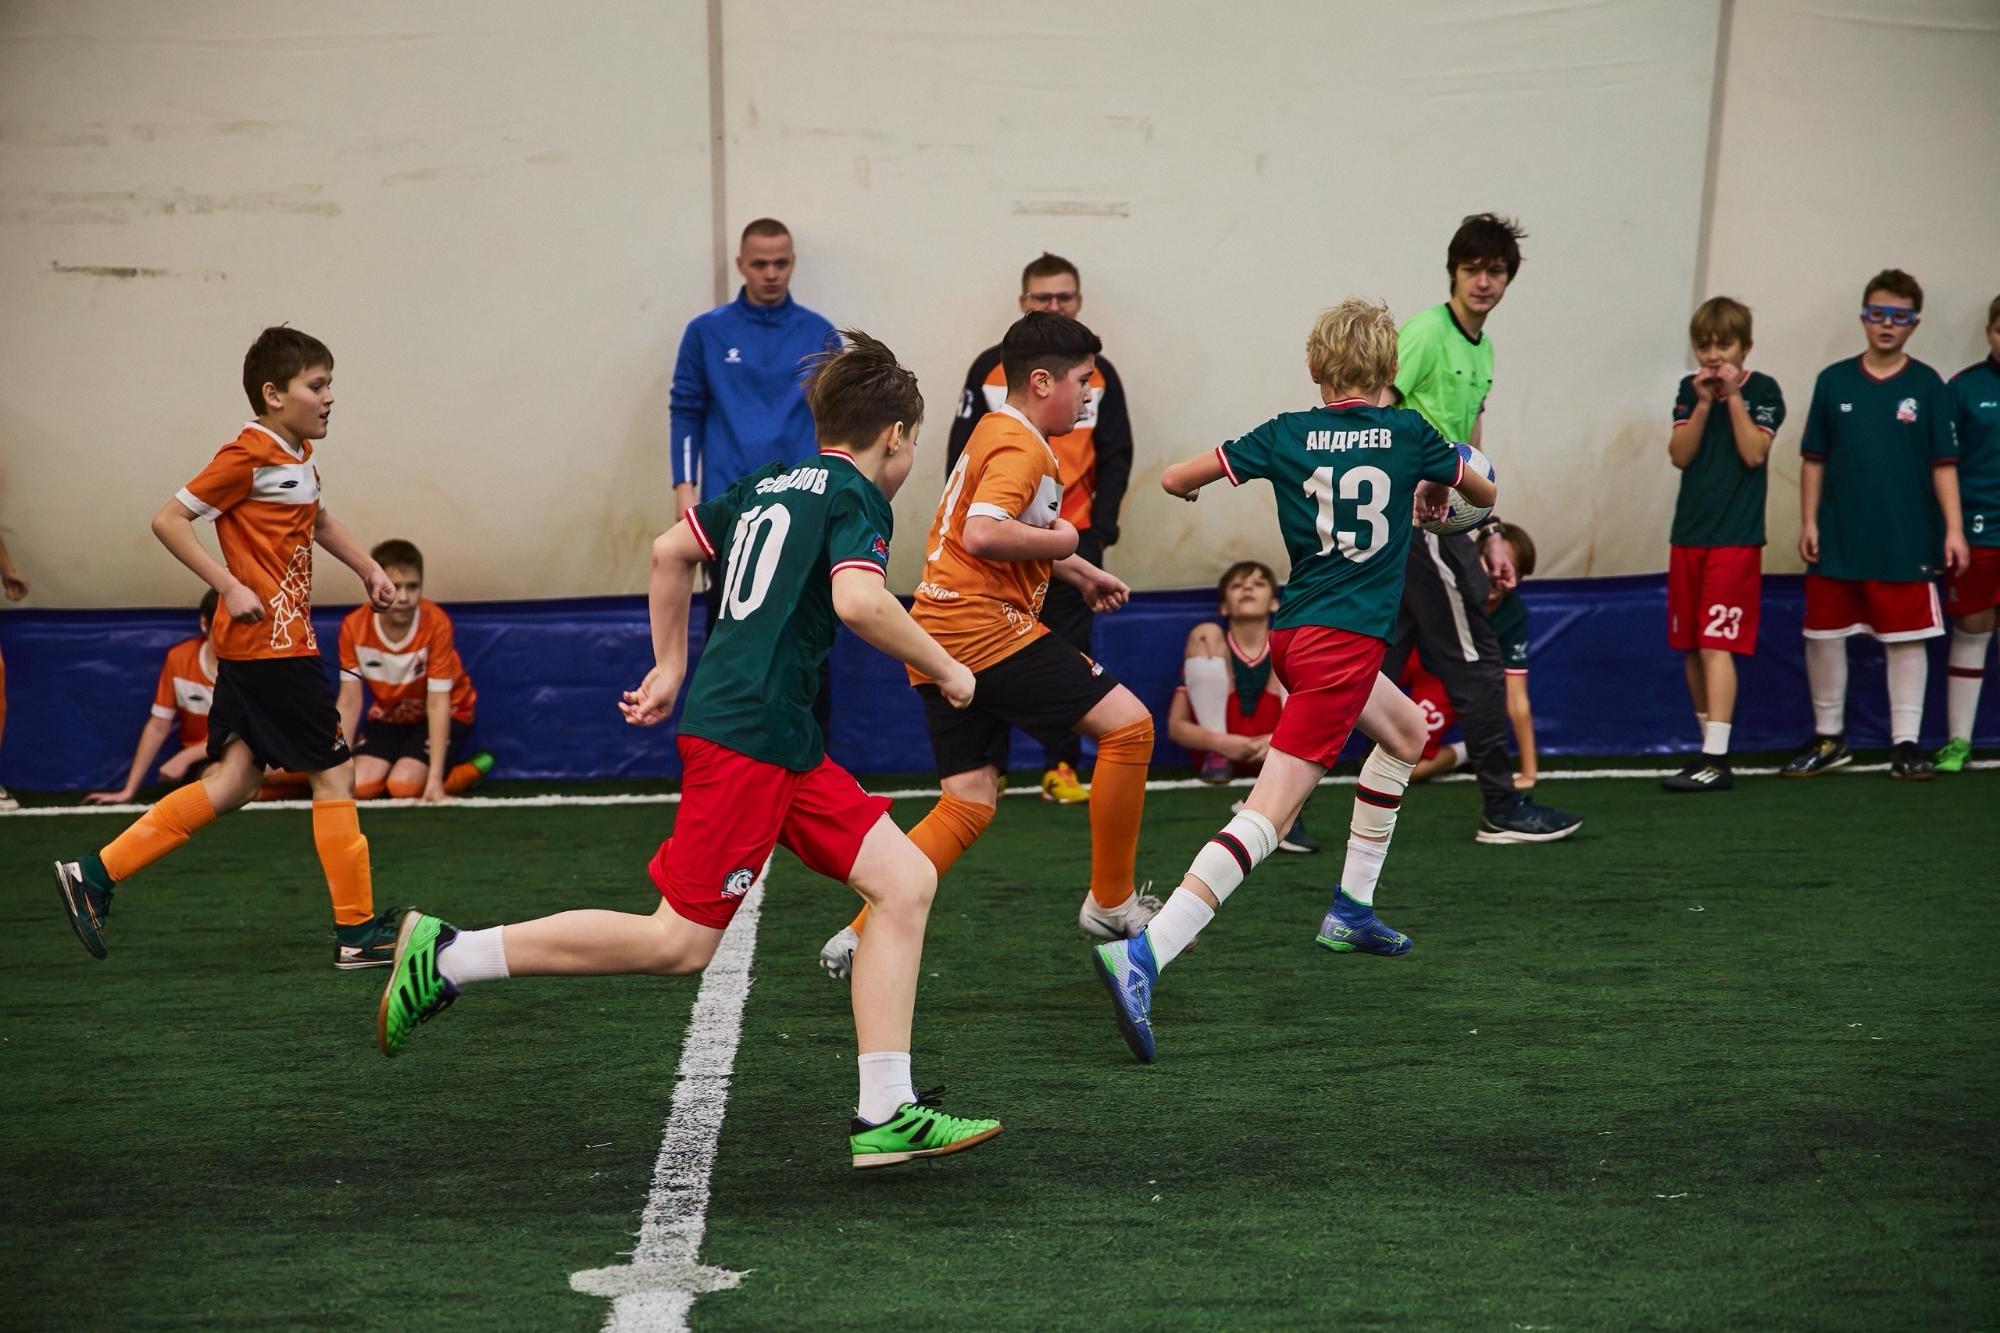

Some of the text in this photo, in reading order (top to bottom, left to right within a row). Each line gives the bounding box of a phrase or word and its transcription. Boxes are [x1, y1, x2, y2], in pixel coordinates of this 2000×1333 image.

[1306, 428, 1392, 452] АНДРЕЕВ
[1302, 465, 1391, 563] 13
[718, 502, 791, 620] 10
[1703, 603, 1743, 640] 23
